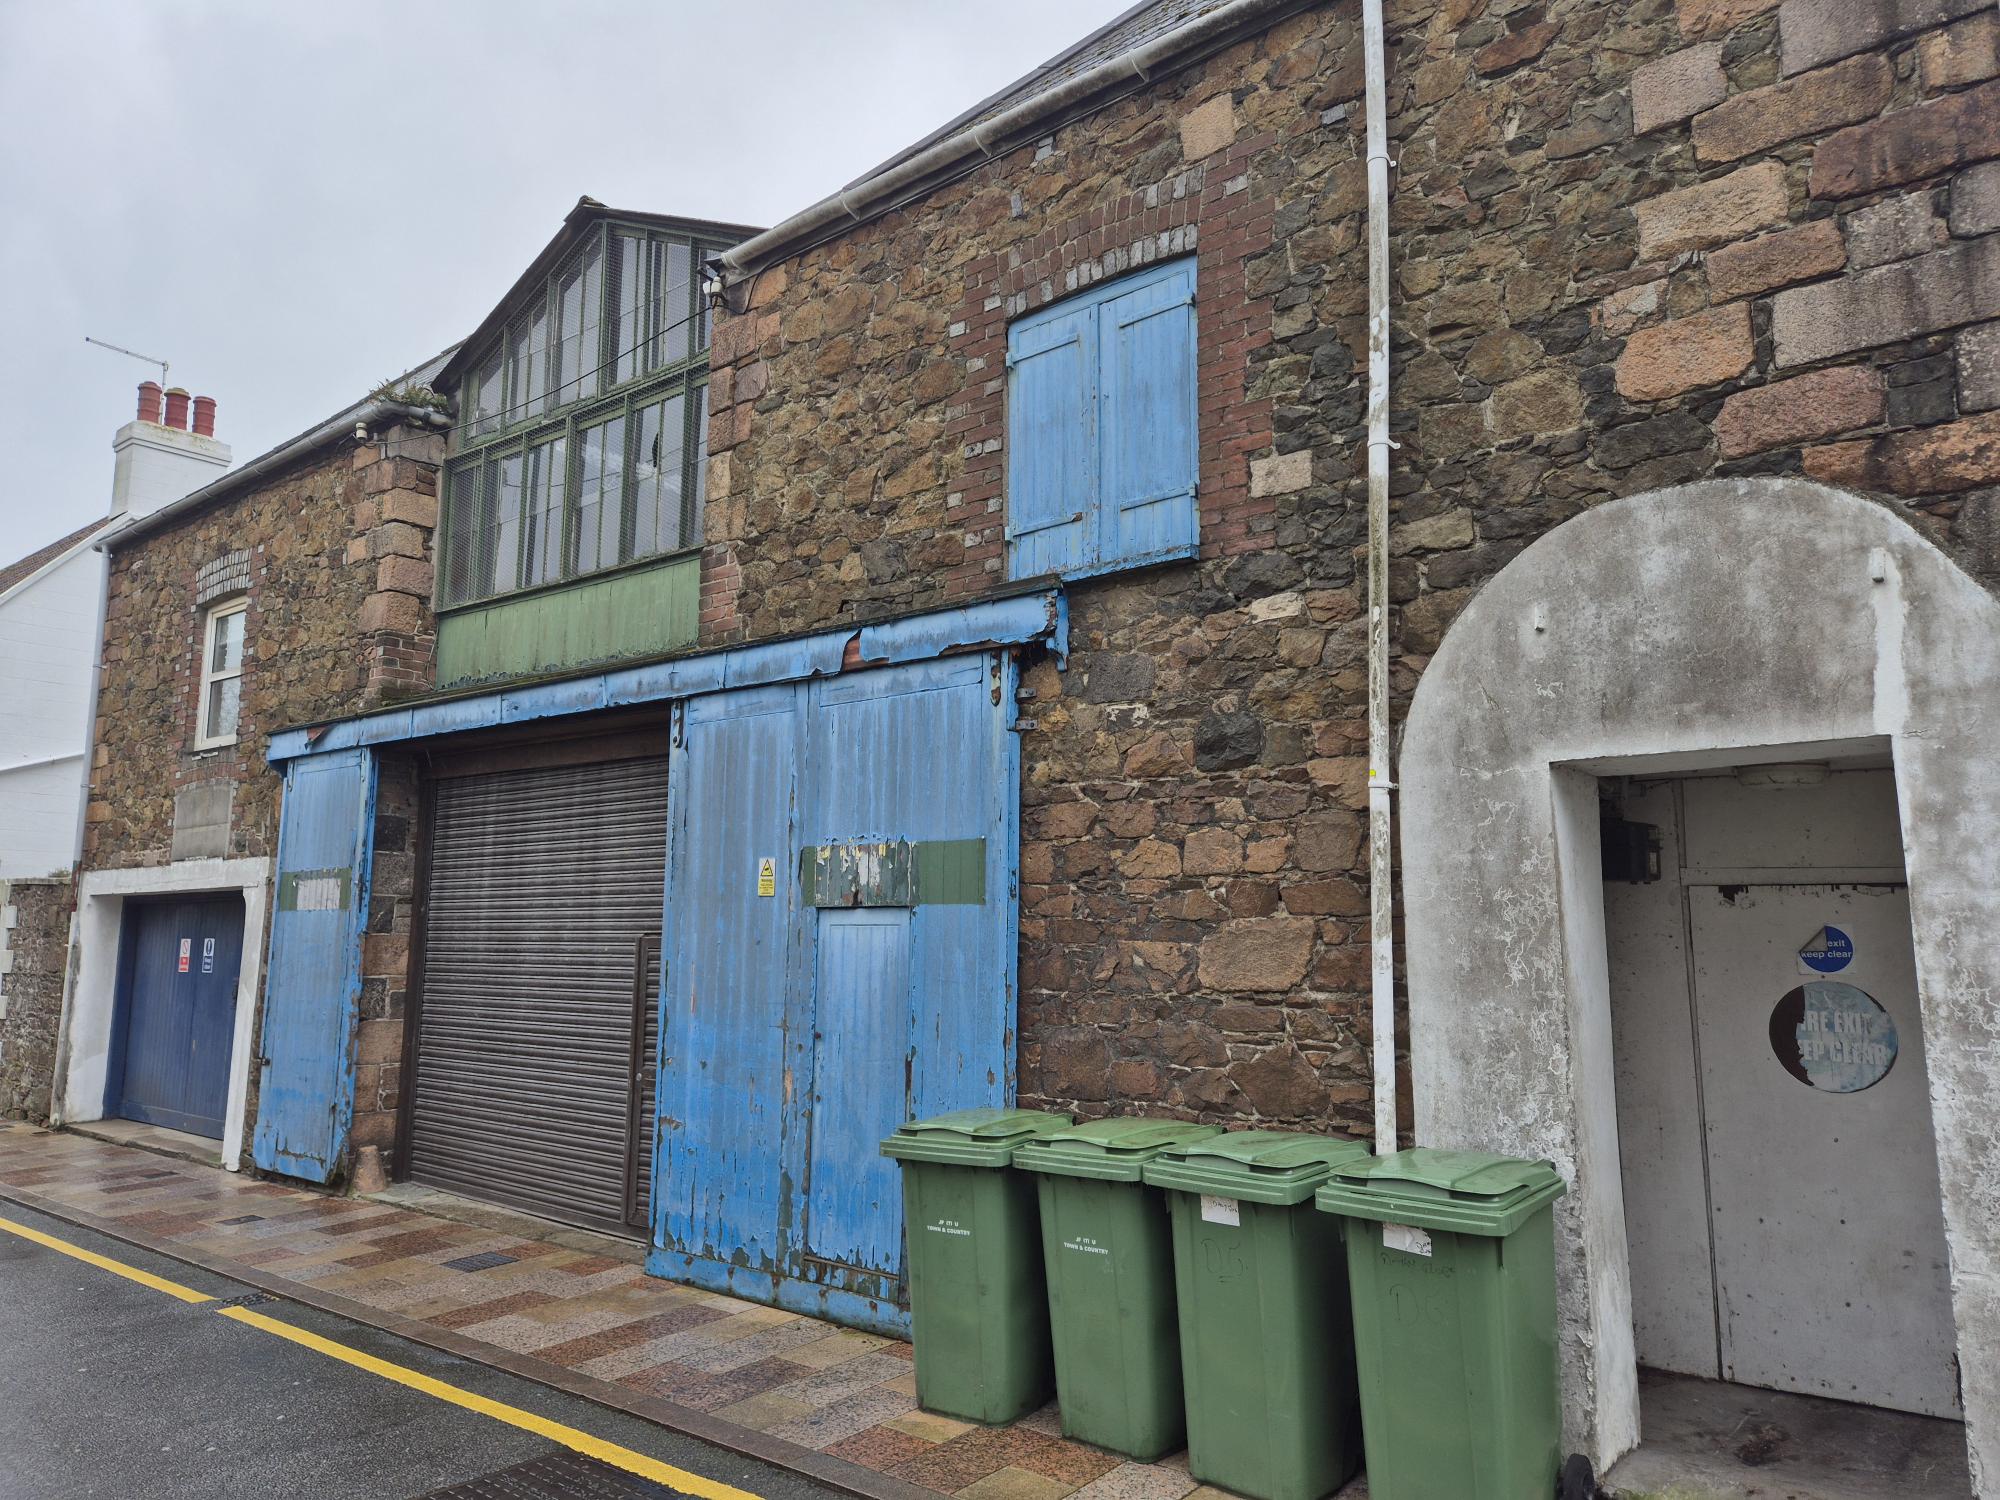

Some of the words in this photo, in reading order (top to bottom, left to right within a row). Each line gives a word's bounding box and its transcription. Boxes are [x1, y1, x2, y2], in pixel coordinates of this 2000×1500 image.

[1827, 939, 1845, 947] exit
[1827, 950, 1852, 958] clear
[947, 1228, 970, 1236] COUNTRY
[1063, 1242, 1078, 1250] TOWN
[1084, 1246, 1108, 1255] COUNTRY
